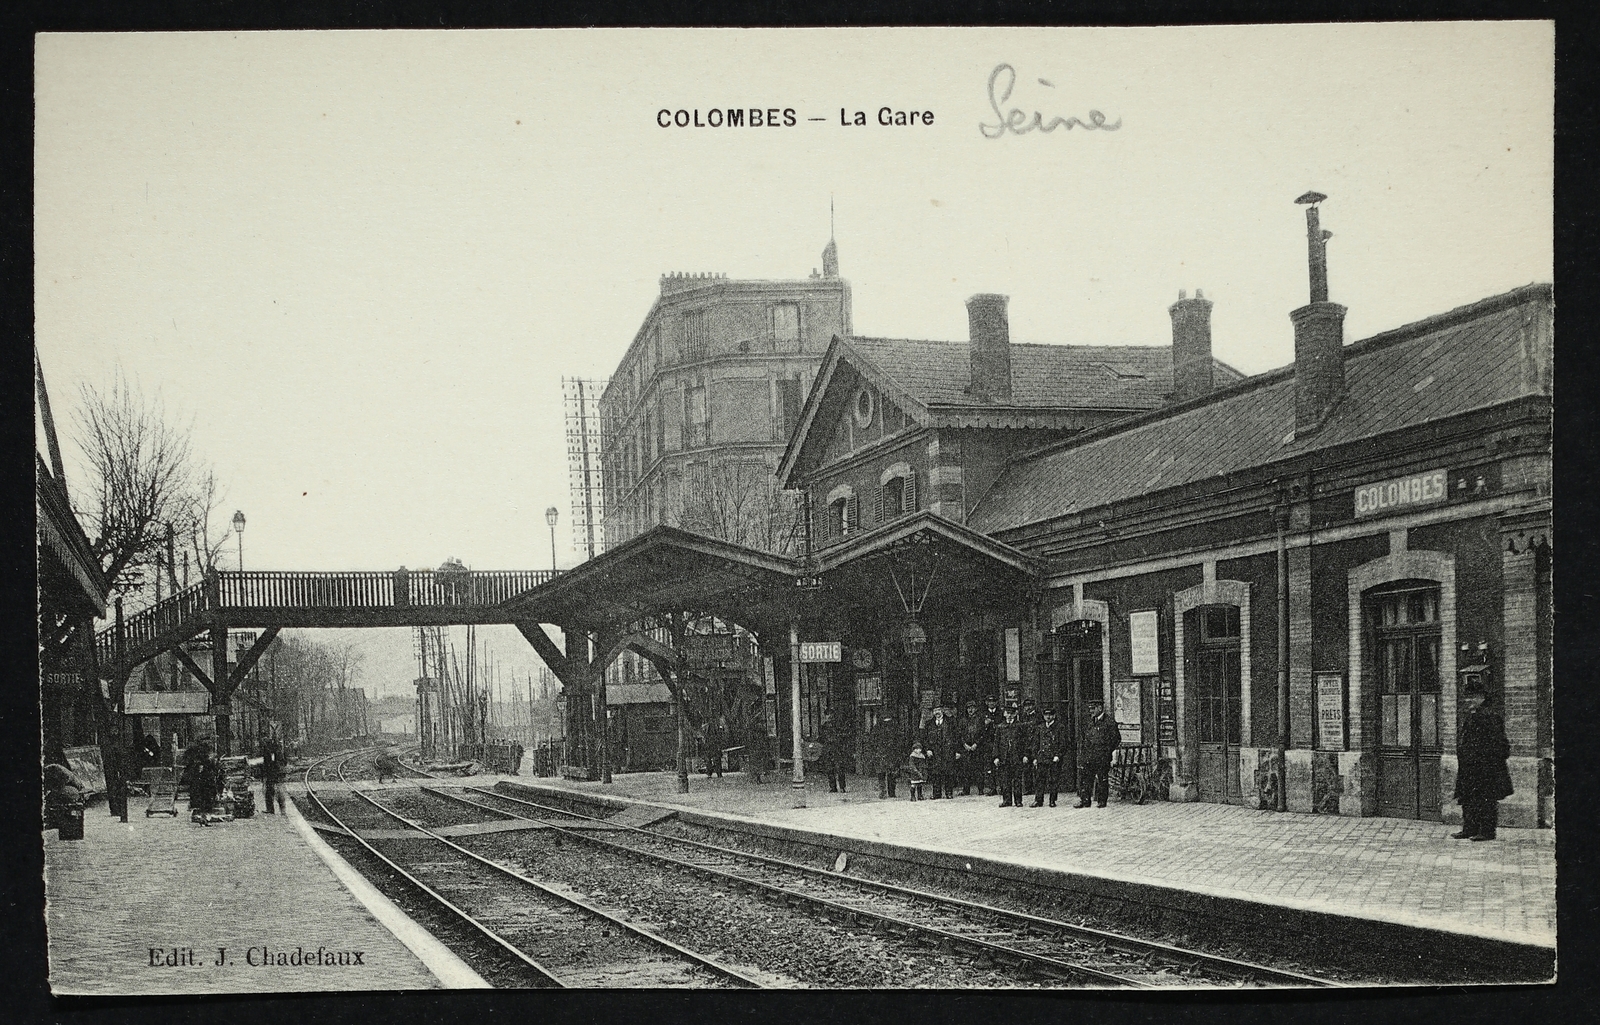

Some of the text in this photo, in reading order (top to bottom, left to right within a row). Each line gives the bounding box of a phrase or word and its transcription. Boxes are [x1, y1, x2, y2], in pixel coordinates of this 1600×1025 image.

[979, 62, 1123, 140] Seine
[1356, 474, 1444, 512] COLOMBES
[801, 644, 839, 660] SORTIE
[46, 673, 81, 684] SORTIE
